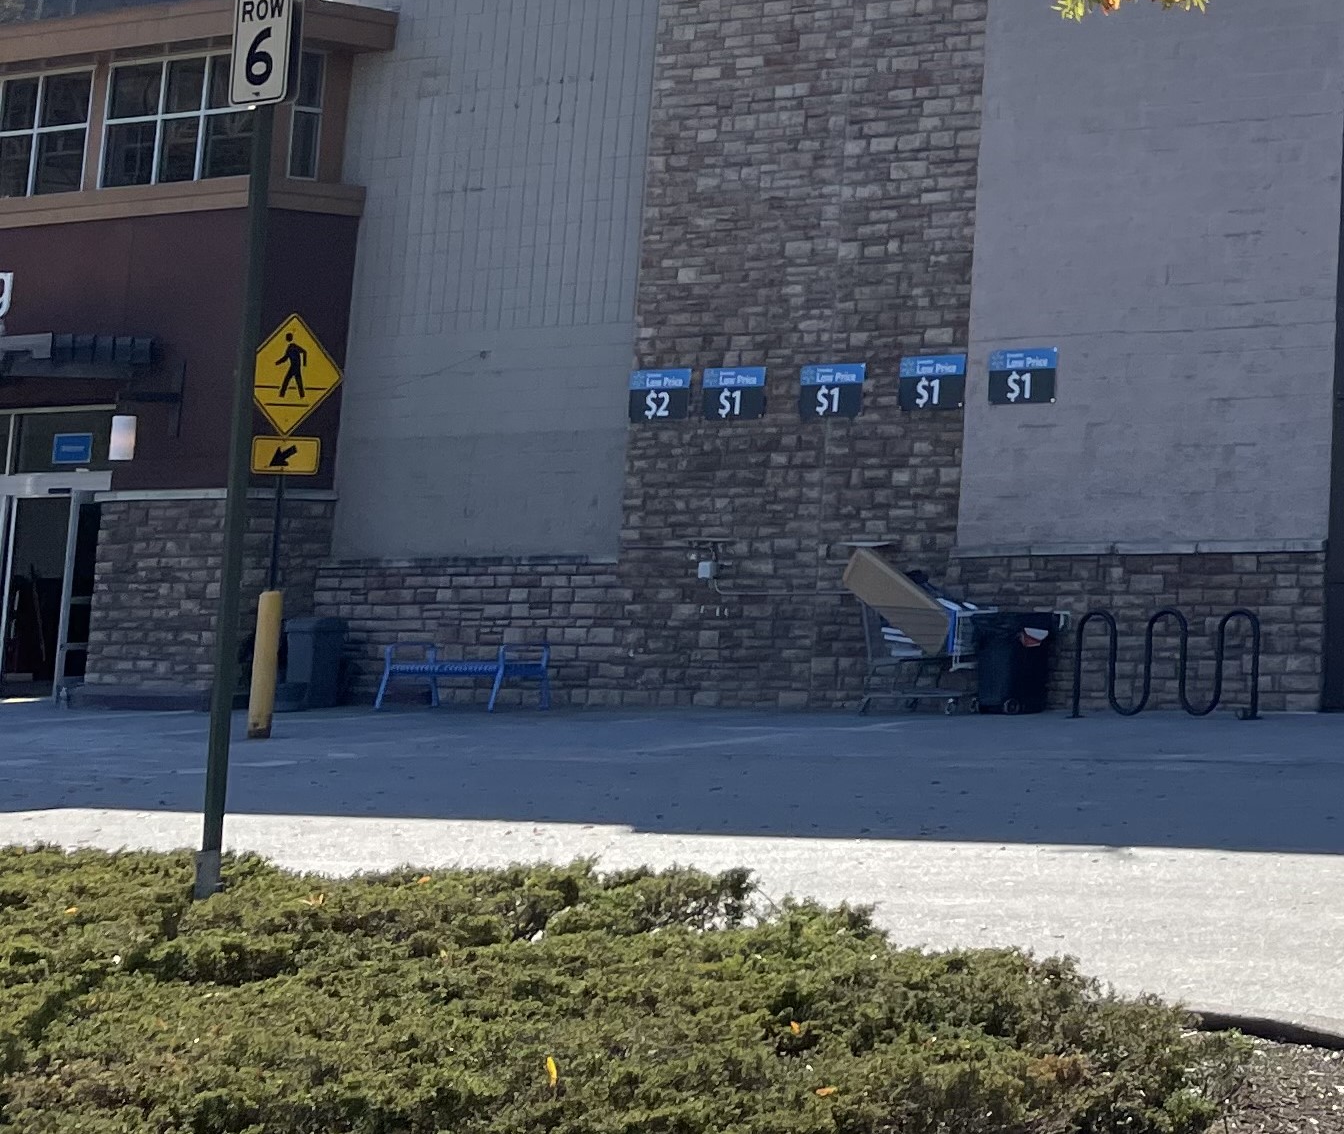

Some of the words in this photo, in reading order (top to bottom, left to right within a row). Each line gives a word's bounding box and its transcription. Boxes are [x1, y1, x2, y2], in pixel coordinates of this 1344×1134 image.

[245, 26, 273, 86] 6
[815, 385, 840, 415] $1
[915, 376, 940, 409] $1
[1006, 371, 1031, 403] $1
[644, 389, 670, 420] $2
[718, 388, 741, 418] $1
